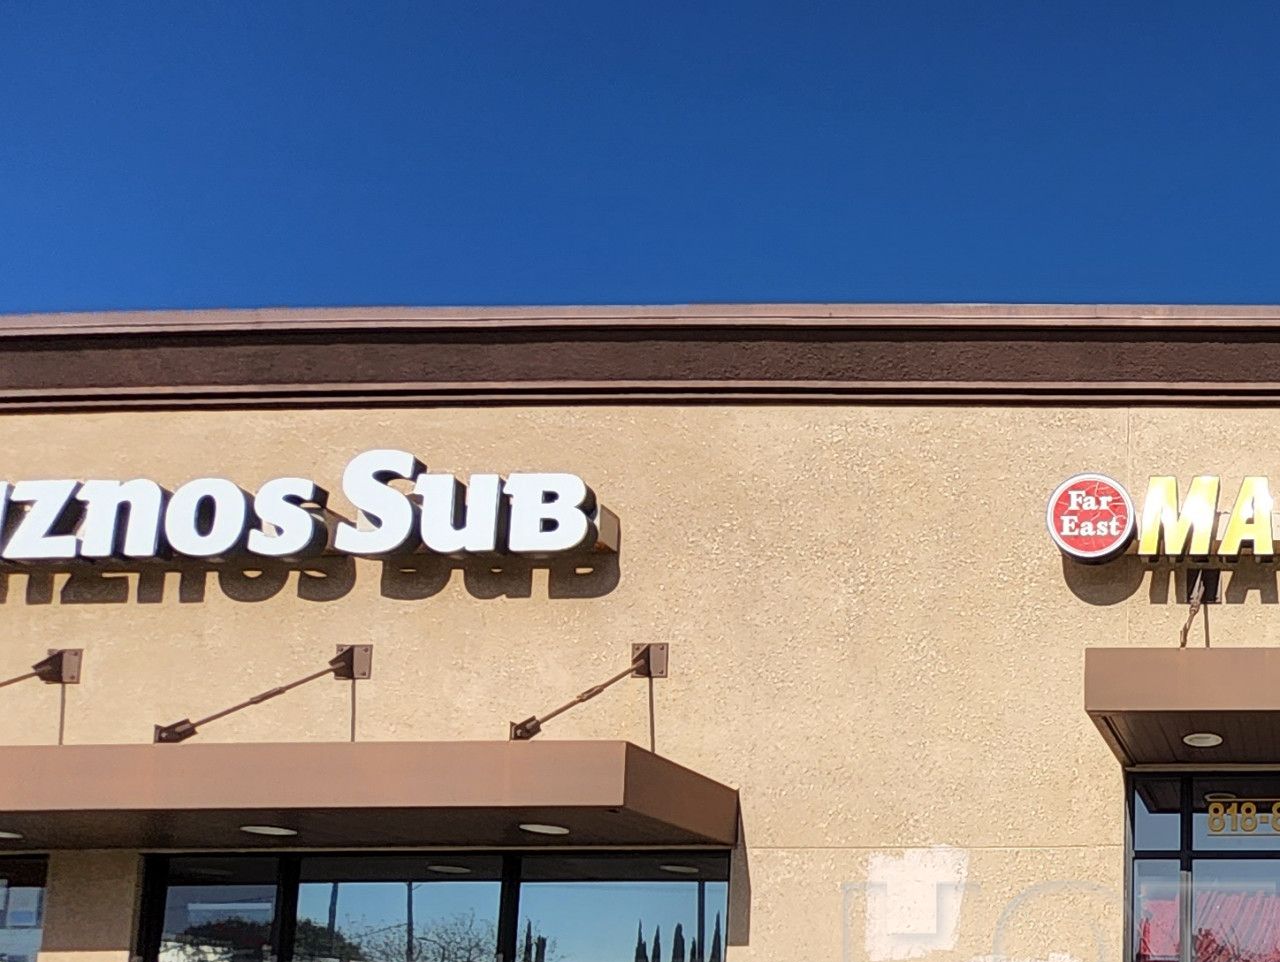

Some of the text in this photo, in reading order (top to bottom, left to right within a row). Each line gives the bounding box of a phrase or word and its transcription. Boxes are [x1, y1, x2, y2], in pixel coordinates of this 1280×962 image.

[1068, 490, 1113, 510] Far
[0, 478, 315, 558] znos
[1060, 515, 1121, 536] East
